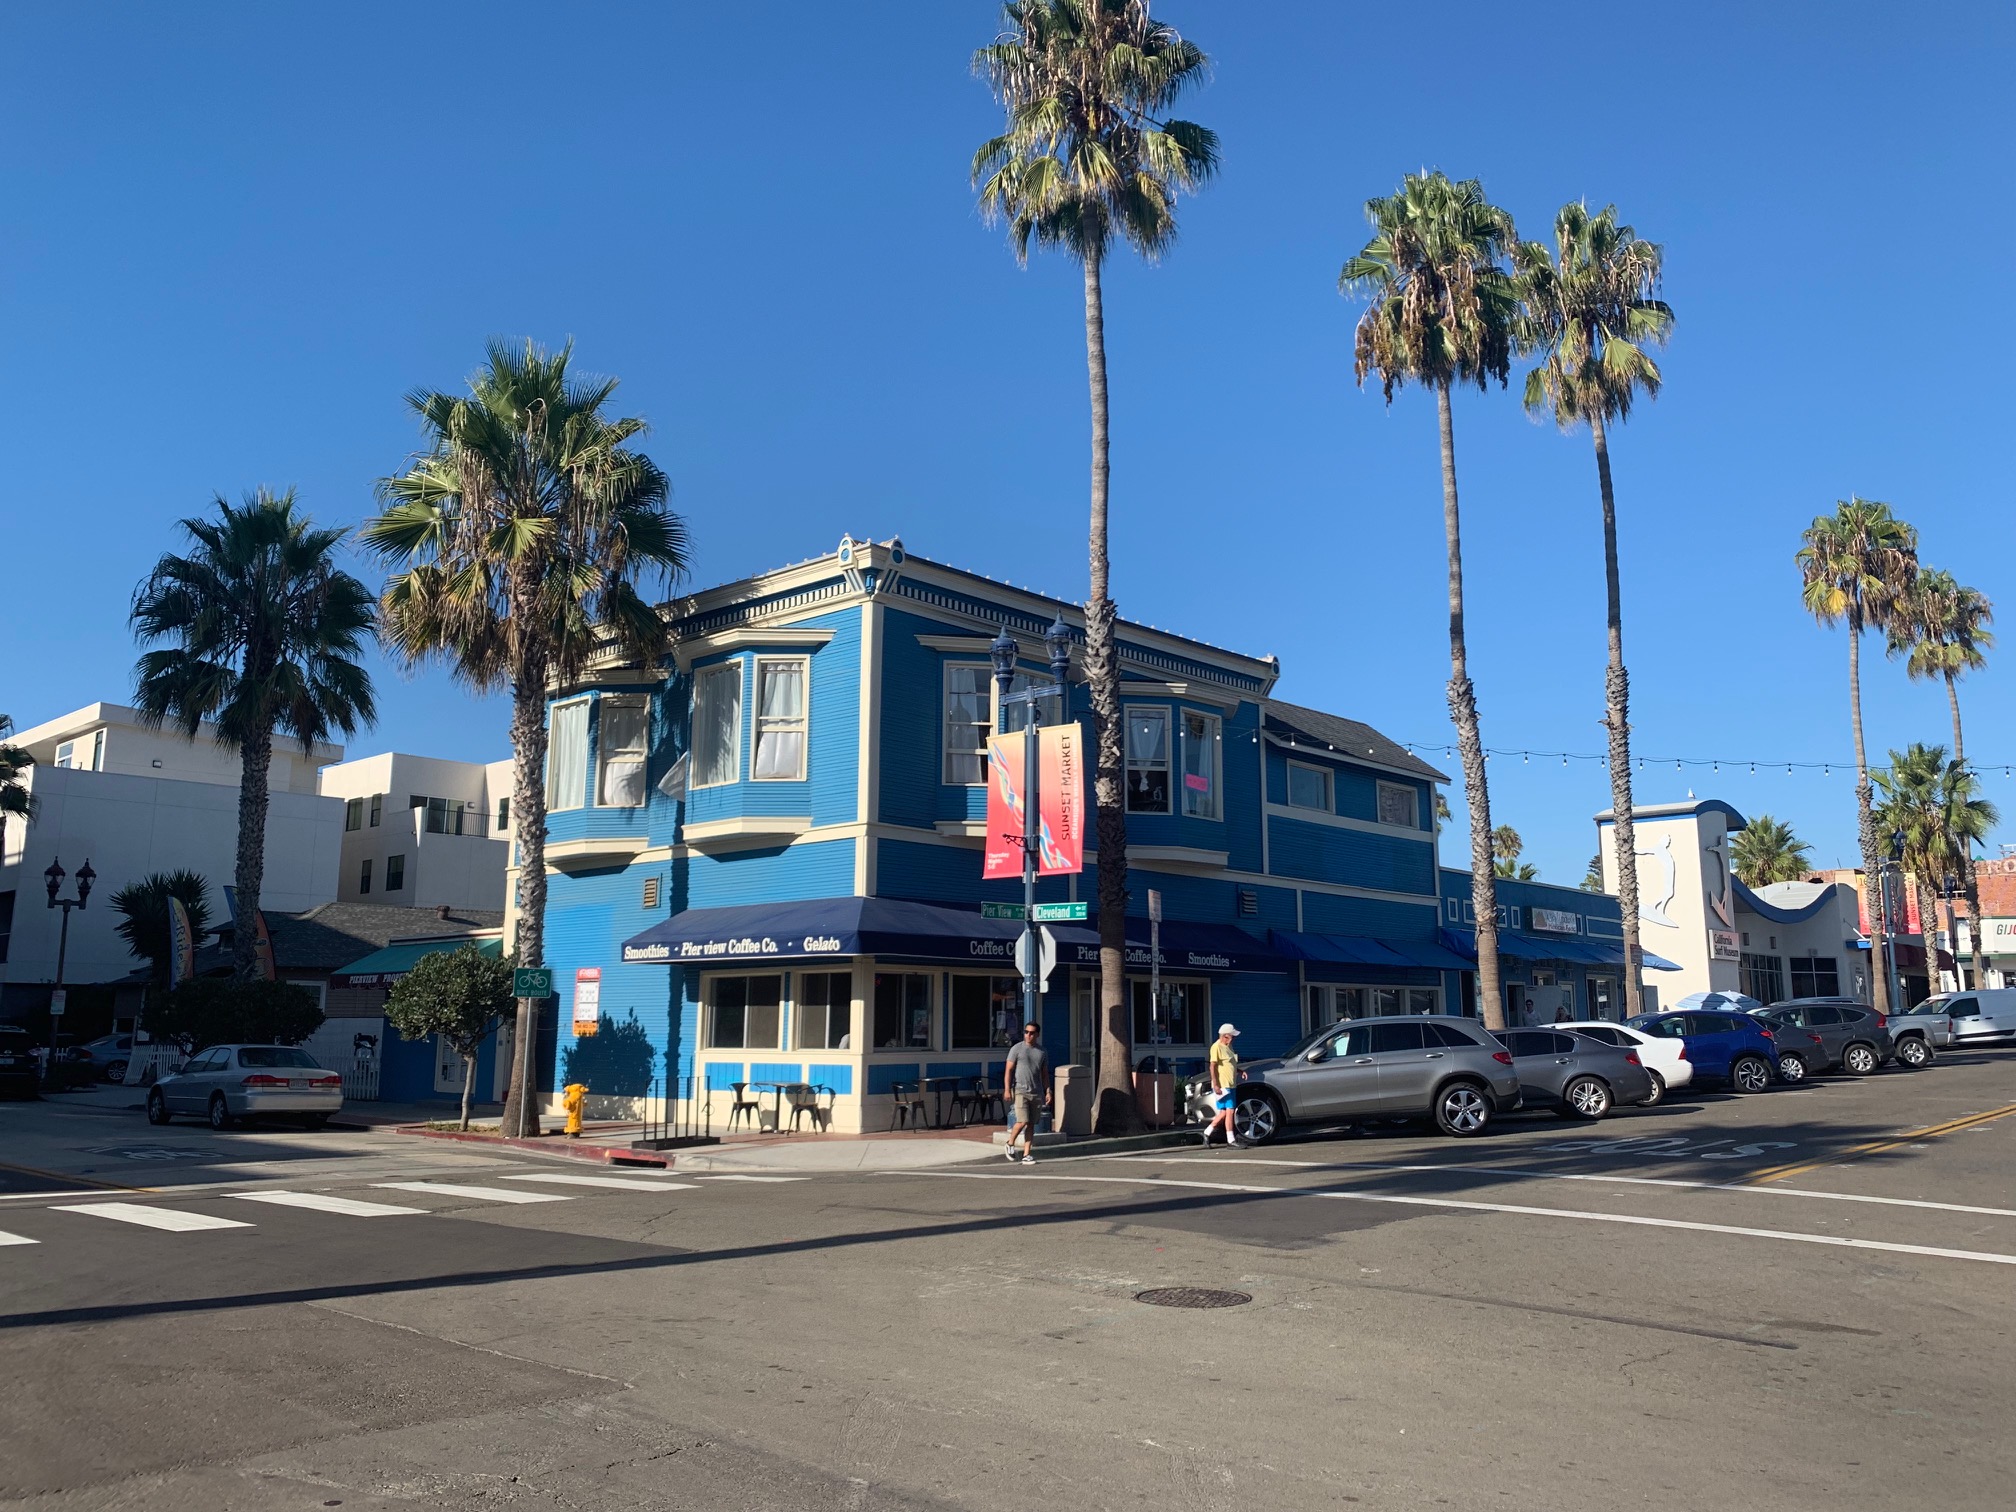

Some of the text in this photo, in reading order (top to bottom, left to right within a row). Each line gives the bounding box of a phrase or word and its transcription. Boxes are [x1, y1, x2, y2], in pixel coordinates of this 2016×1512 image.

[1061, 735, 1071, 840] SUNSET MARKET
[982, 904, 995, 917] Pier
[997, 905, 1012, 918] View
[1037, 906, 1071, 919] Cleveland
[1909, 900, 1917, 921] SUNSET
[1714, 933, 1733, 945] California
[624, 936, 840, 960] Smoothies Pier view Coffee Co. Gelato
[970, 940, 1004, 955] Coffee
[1714, 945, 1739, 957] Surf Museum
[1077, 946, 1098, 960] Pier
[1125, 949, 1151, 963] Coffee
[1188, 952, 1230, 967] Smoothies
[349, 974, 379, 984] PIERVIEW
[1532, 1136, 1798, 1159] STOP
